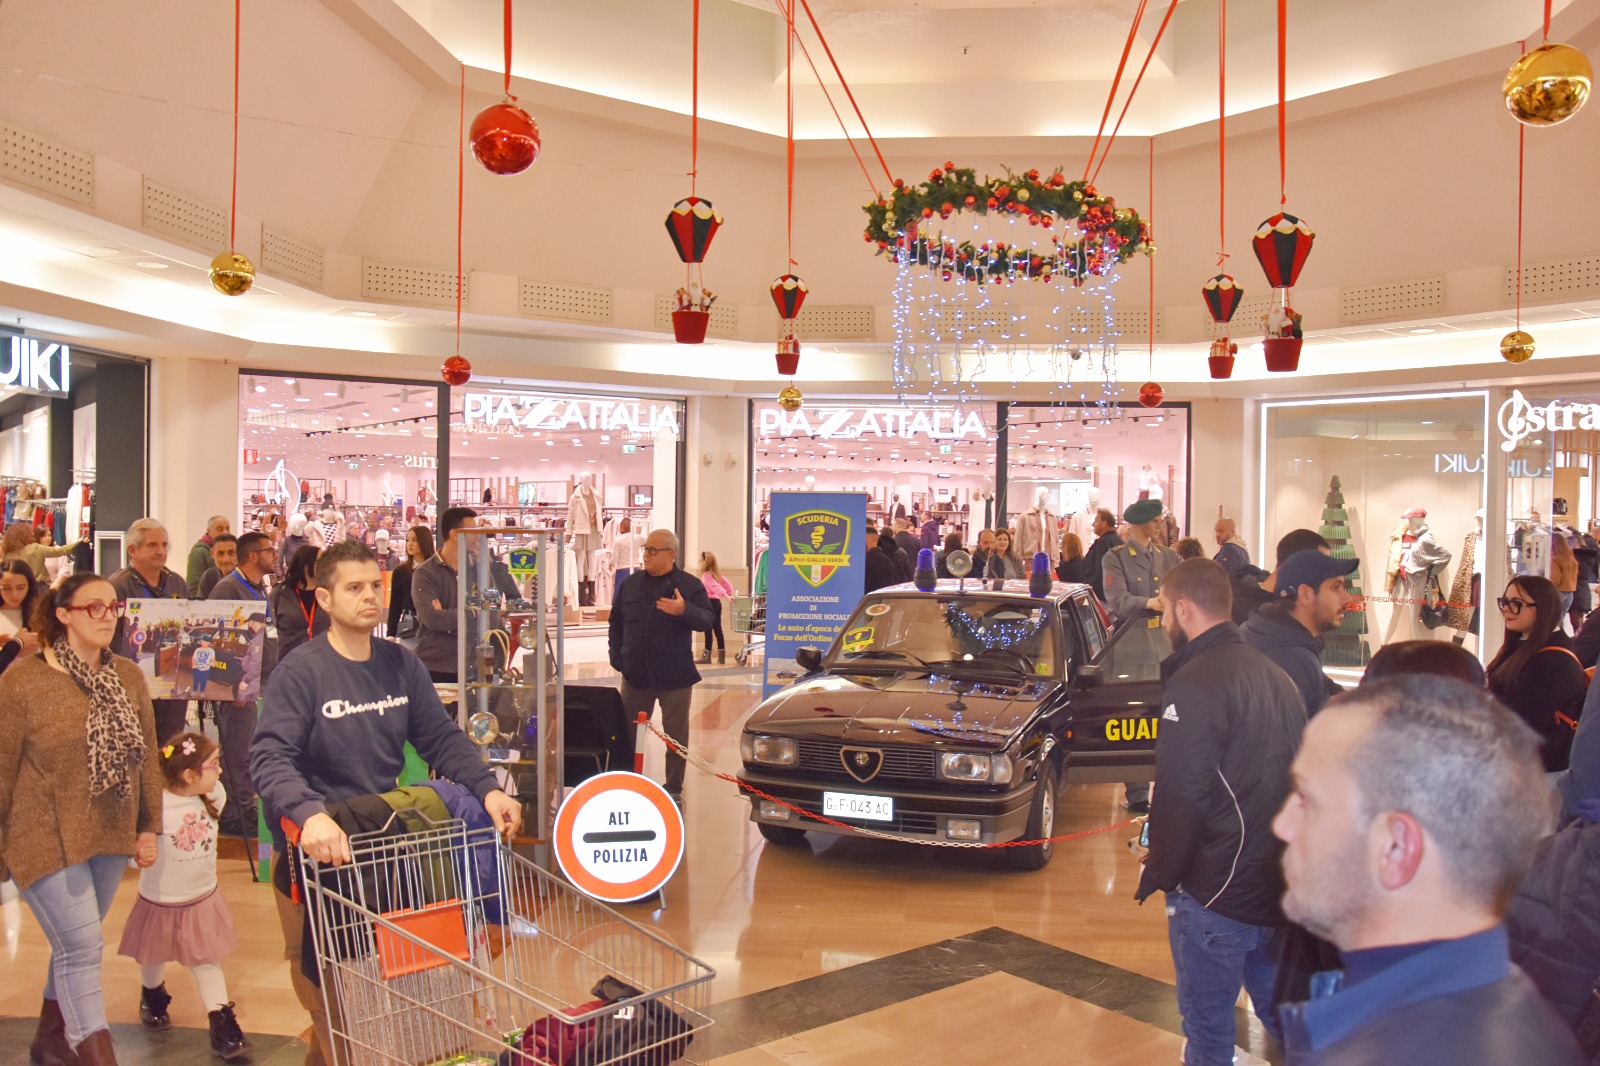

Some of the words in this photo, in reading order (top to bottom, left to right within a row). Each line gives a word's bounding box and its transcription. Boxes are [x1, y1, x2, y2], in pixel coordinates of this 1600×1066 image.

[796, 514, 839, 526] SCUDERIA
[791, 595, 840, 603] ASSOCIAZIONE
[778, 612, 823, 620] PROMOZIONE
[773, 633, 793, 641] Forze
[322, 695, 408, 718] Champion
[608, 811, 631, 826] ALT
[593, 847, 649, 864] POLIZIA
